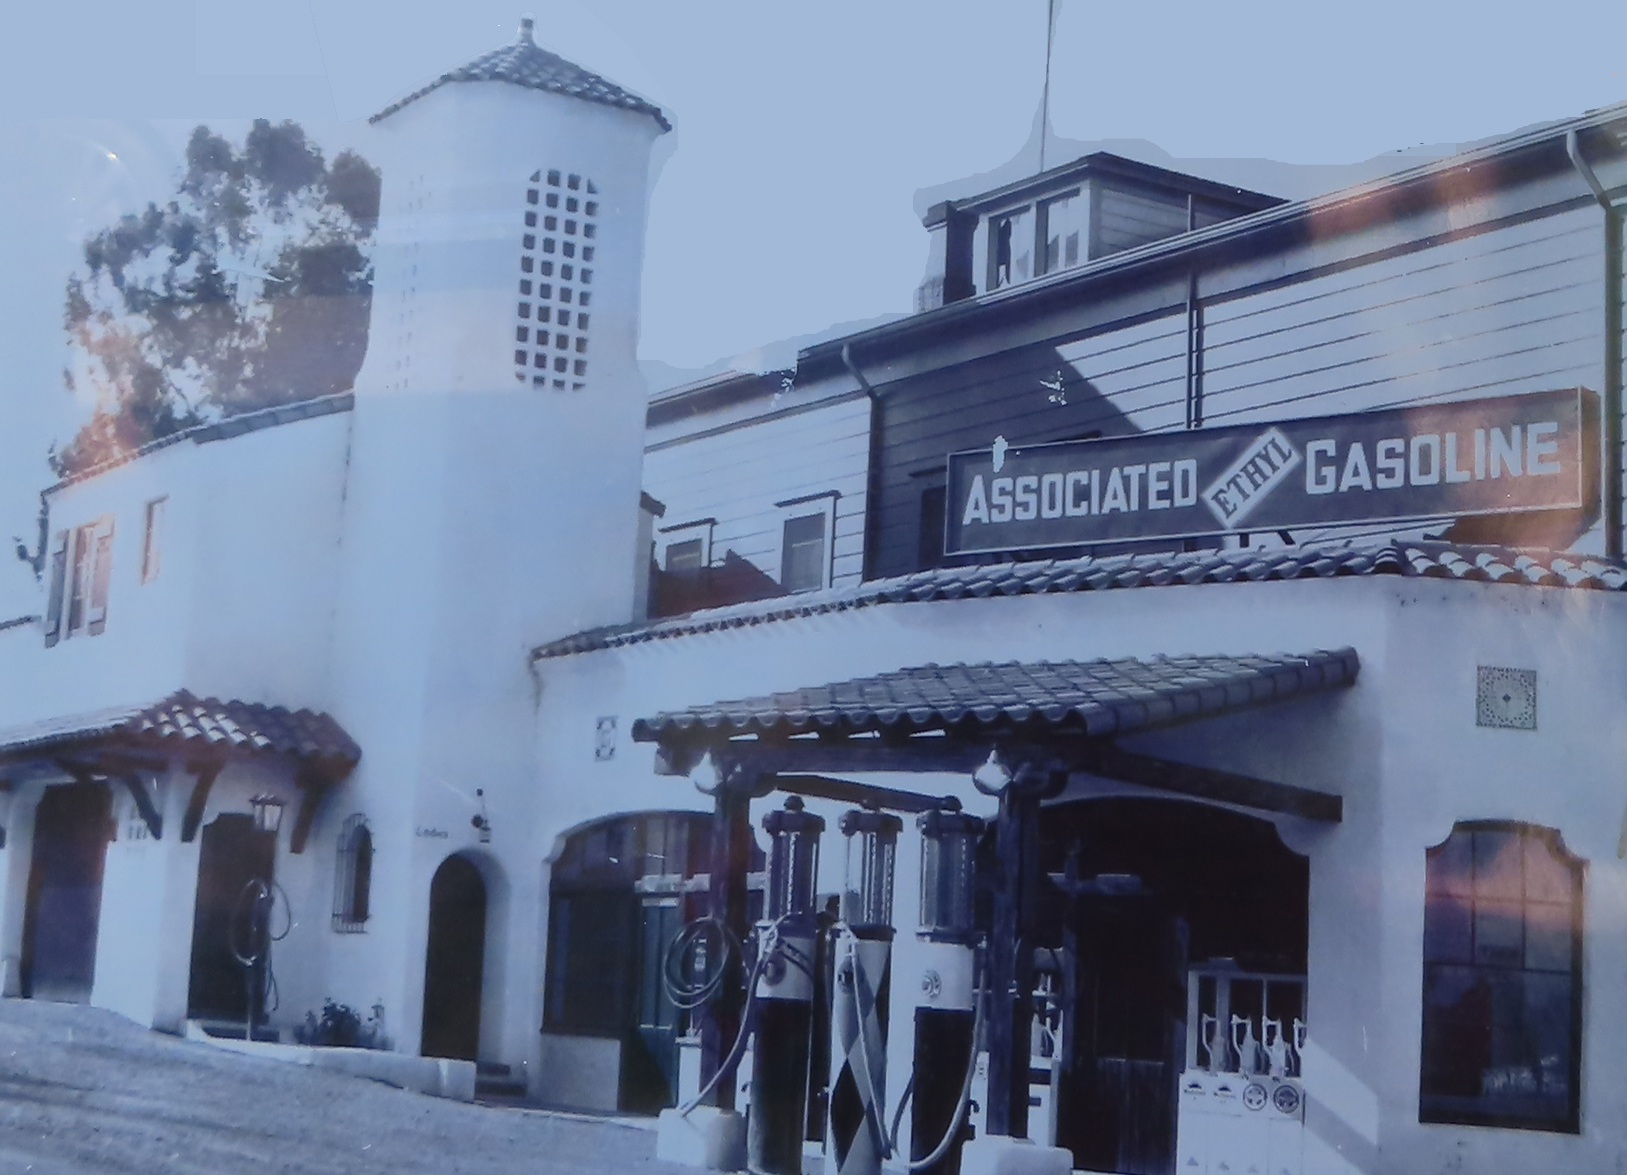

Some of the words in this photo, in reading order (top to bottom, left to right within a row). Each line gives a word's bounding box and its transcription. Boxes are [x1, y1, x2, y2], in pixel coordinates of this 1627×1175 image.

[963, 459, 1197, 525] ASSOCIATED
[1210, 436, 1293, 519] ETHYL
[1306, 422, 1560, 494] GASOLINE
